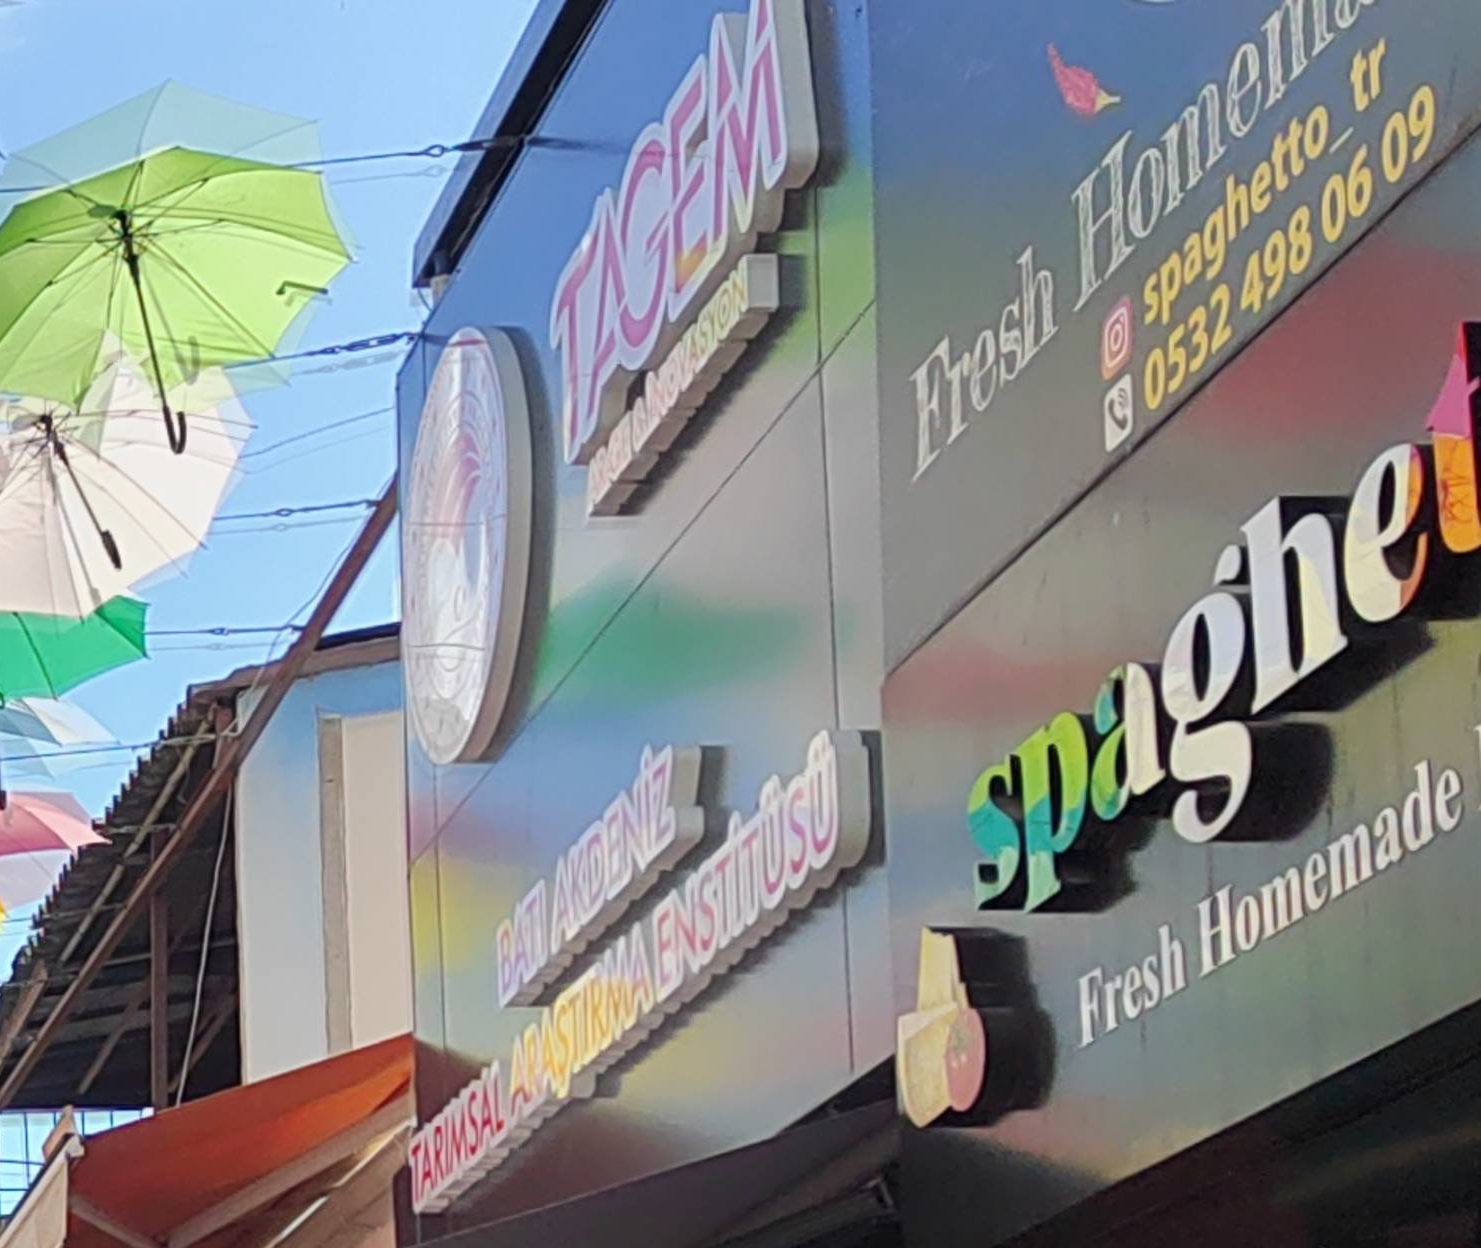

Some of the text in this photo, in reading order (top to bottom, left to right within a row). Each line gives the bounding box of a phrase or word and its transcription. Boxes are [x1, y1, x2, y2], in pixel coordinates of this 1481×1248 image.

[553, 0, 786, 460] TAGEM
[909, 245, 1060, 483] Fresh
[1144, 84, 1435, 410] 0532 498 06 09
[409, 729, 839, 1212] TARIMSAL ARAŞTIRMA ENSTİTÜSÜ
[497, 744, 676, 1008] BATI AKDENİZ
[1077, 922, 1187, 1049] Fresh
[1197, 758, 1463, 980] Homemade
